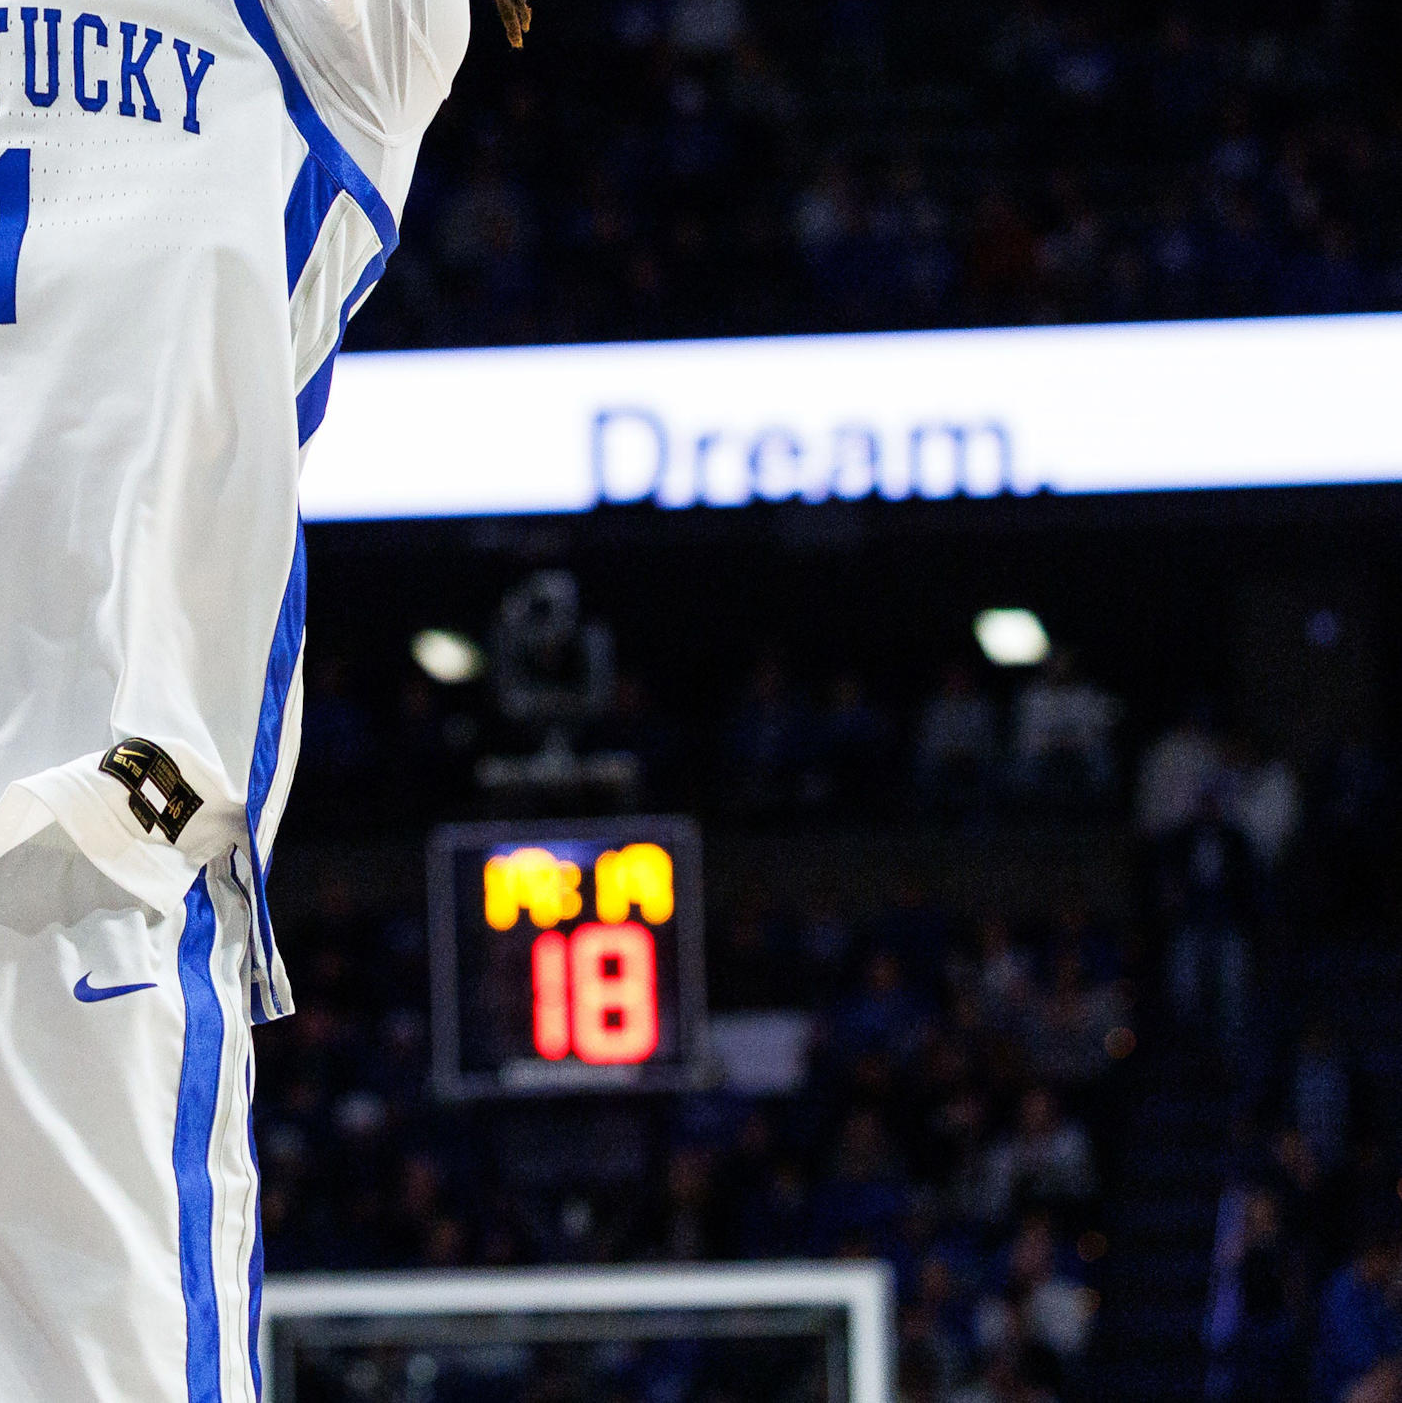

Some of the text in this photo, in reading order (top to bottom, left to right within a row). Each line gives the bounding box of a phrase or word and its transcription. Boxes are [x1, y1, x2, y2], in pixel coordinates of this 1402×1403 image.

[113, 754, 142, 777] ELITE
[167, 796, 183, 818] 46
[532, 921, 659, 1065] 18
